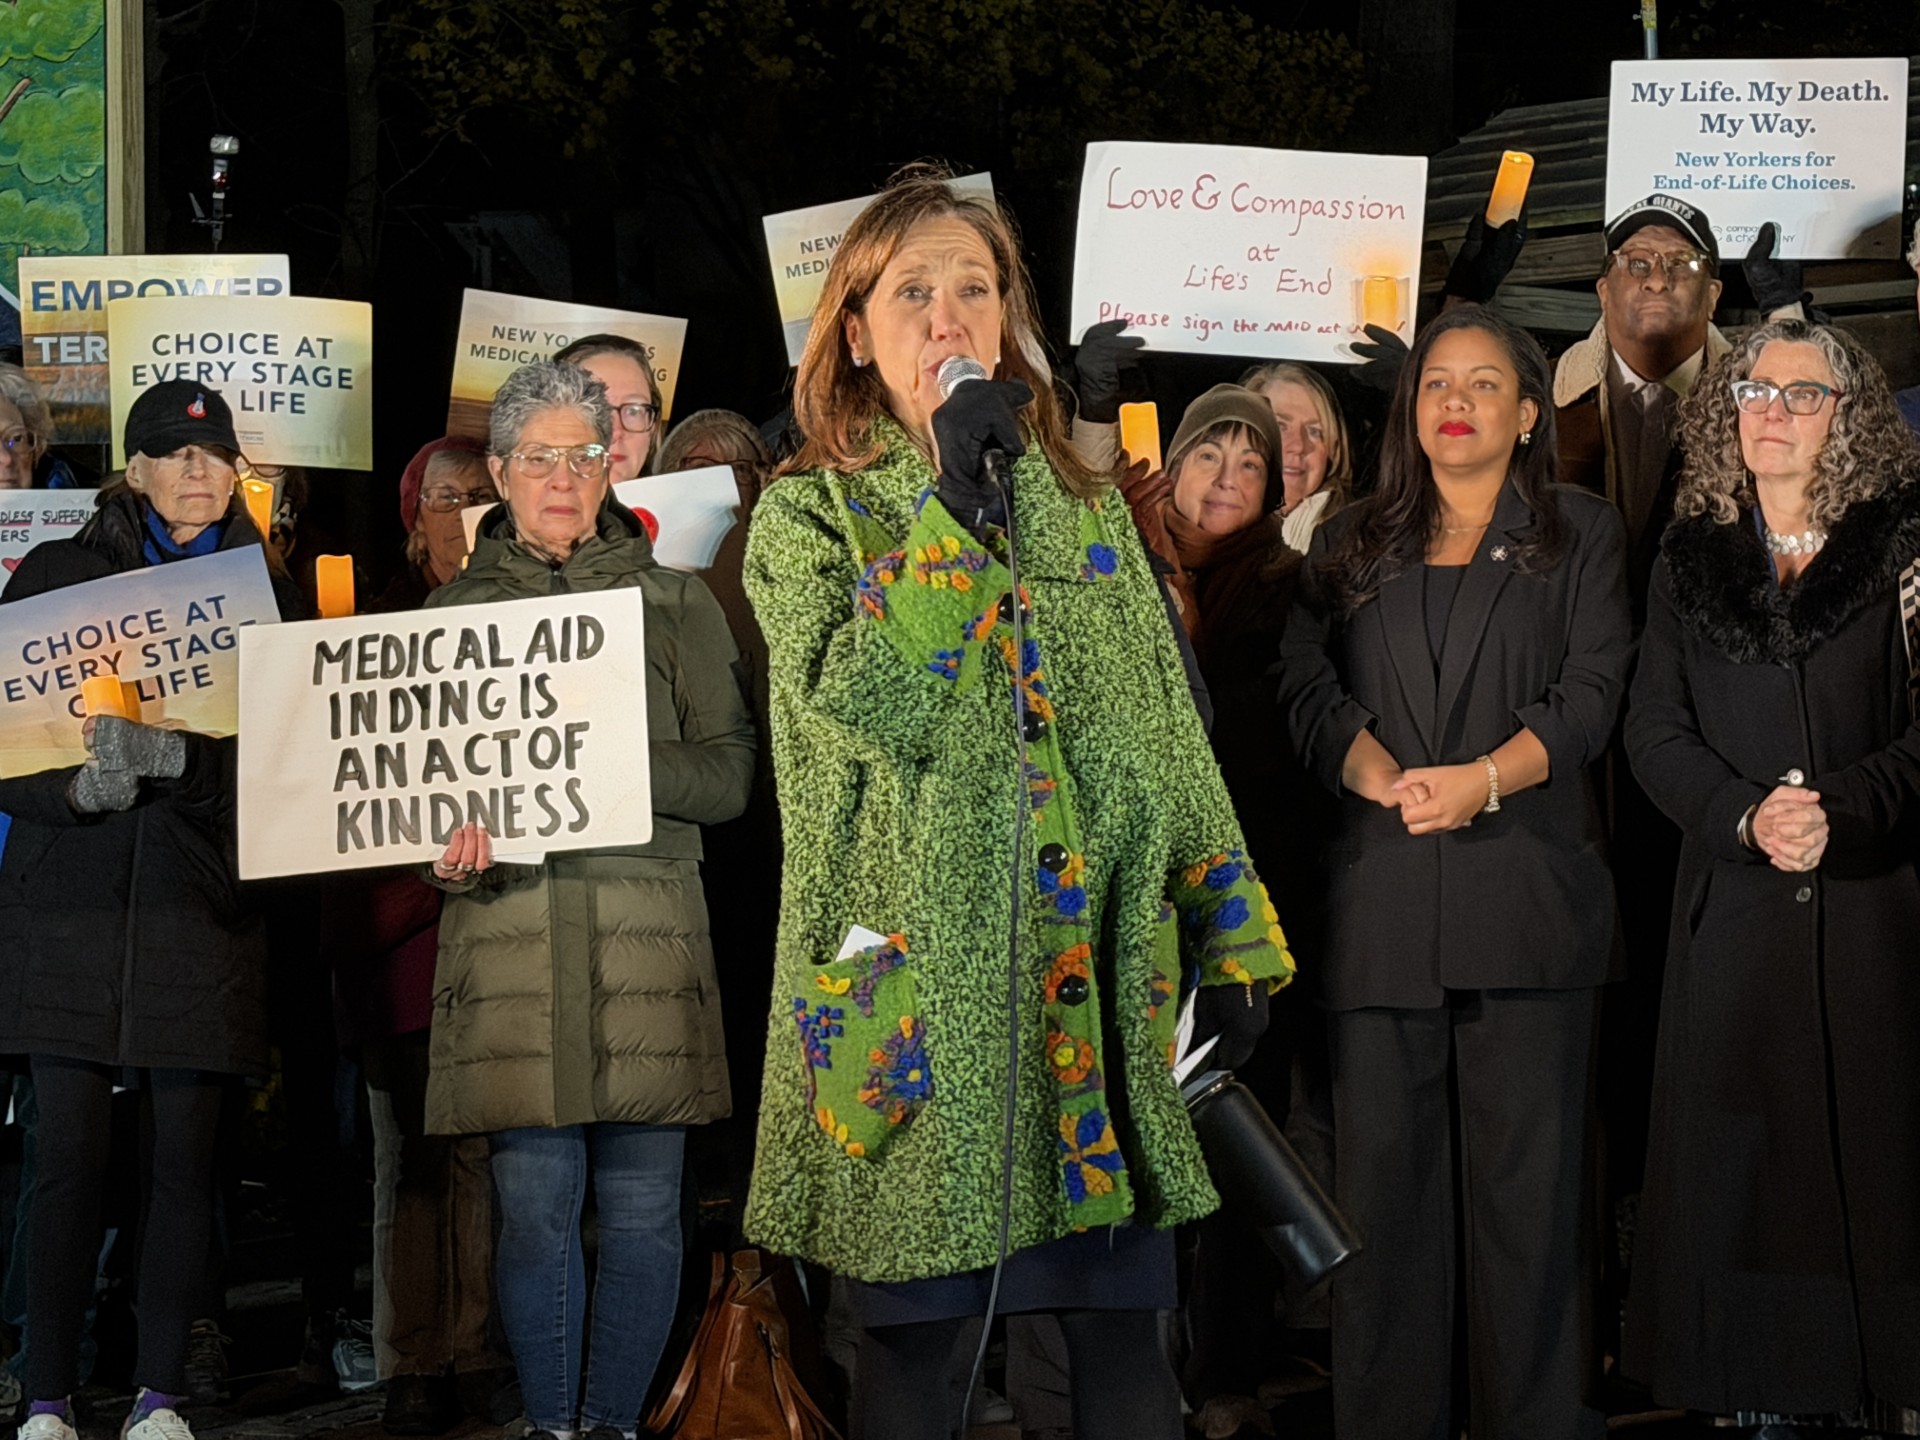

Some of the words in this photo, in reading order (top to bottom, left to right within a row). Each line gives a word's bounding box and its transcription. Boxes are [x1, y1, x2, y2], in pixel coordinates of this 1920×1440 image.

[1631, 82, 1675, 106] My
[1680, 81, 1741, 102] Life.
[1748, 81, 1792, 106] My
[1798, 80, 1889, 101] Death.
[1700, 113, 1744, 137] My
[1750, 113, 1816, 137] Way.
[1675, 152, 1720, 167] New
[1723, 152, 1801, 167] Yorkers
[1805, 151, 1835, 167] for
[1653, 174, 1767, 190] End-of-Life
[1771, 174, 1856, 190] Choices.
[1107, 167, 1184, 210] Love
[1191, 174, 1221, 211] &
[1230, 182, 1406, 236] Compassion
[1652, 196, 1695, 220] GIANTS
[800, 234, 842, 254] NEW
[1247, 244, 1280, 262] at
[786, 258, 830, 279] MEDI
[1183, 264, 1249, 291] Life's
[1276, 267, 1332, 295] End
[1099, 302, 1170, 328] Please
[1183, 313, 1224, 341] sign
[1233, 319, 1259, 333] the
[1317, 323, 1341, 334] act
[33, 335, 108, 365] TER
[152, 332, 279, 357] CHOICE
[294, 335, 334, 360] AT
[491, 324, 537, 343] NEW
[543, 331, 570, 348] YO
[132, 361, 237, 387] EVERY
[252, 362, 354, 390] STAGE
[240, 389, 306, 414] LIFE
[0, 510, 34, 523] DLESS
[41, 509, 94, 523] SUFFERI
[0, 529, 30, 543] ERS
[22, 608, 165, 665] CHOICE
[185, 594, 226, 627] AT
[4, 650, 122, 703] EVERY
[141, 619, 257, 668] STAG
[312, 624, 514, 685] MEDICAL
[524, 614, 605, 664] AID
[135, 664, 214, 703] LIFE
[329, 689, 377, 740] IN
[520, 672, 558, 719] IS
[333, 741, 408, 792] AN
[421, 728, 521, 783] ACT
[528, 721, 590, 771] OF
[337, 777, 590, 854] KINDNESS
